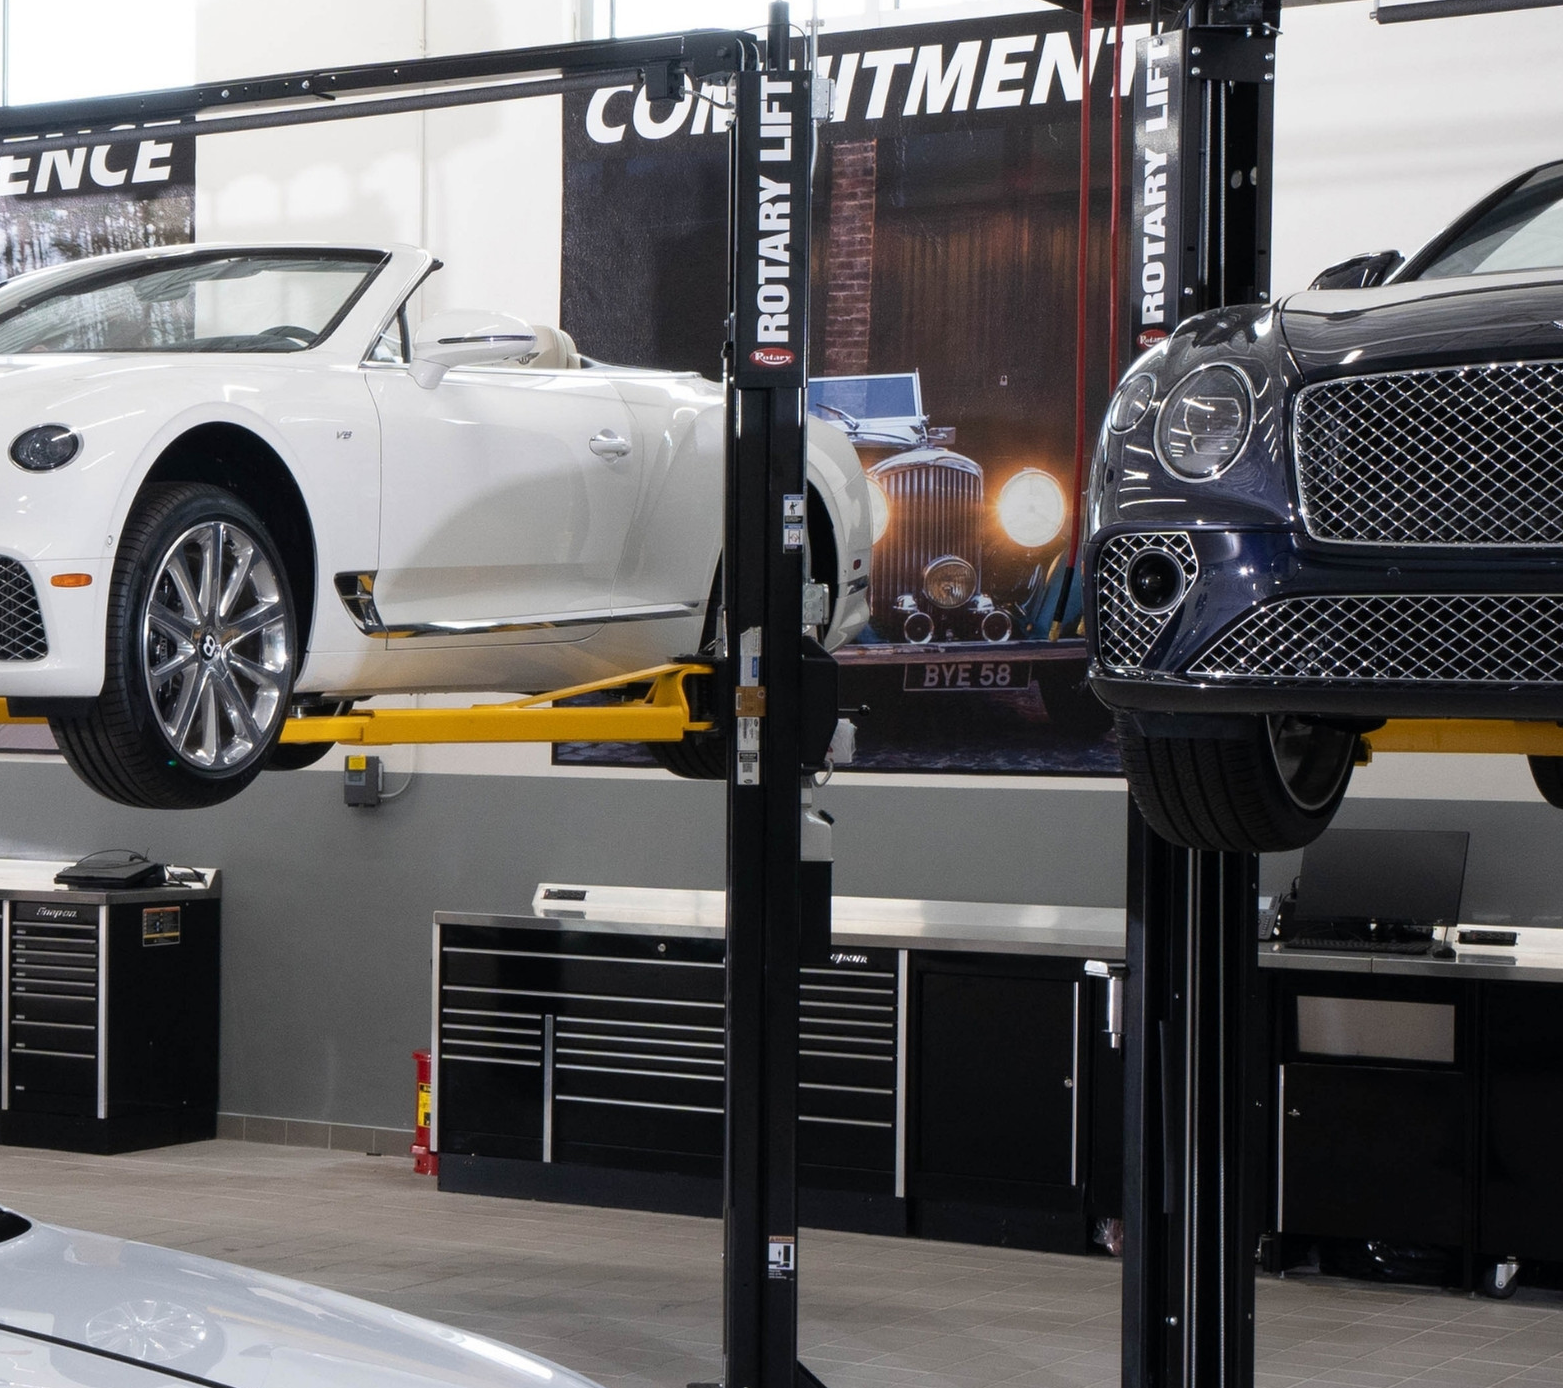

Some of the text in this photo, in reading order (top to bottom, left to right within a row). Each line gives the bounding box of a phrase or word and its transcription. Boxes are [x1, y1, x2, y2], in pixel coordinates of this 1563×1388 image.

[586, 22, 1164, 144] COITMENT
[757, 75, 793, 343] ROTARY LIFT
[1140, 41, 1170, 325] ROTARY LIFT
[755, 351, 791, 365] Rotary
[923, 663, 1011, 687] BYE 58
